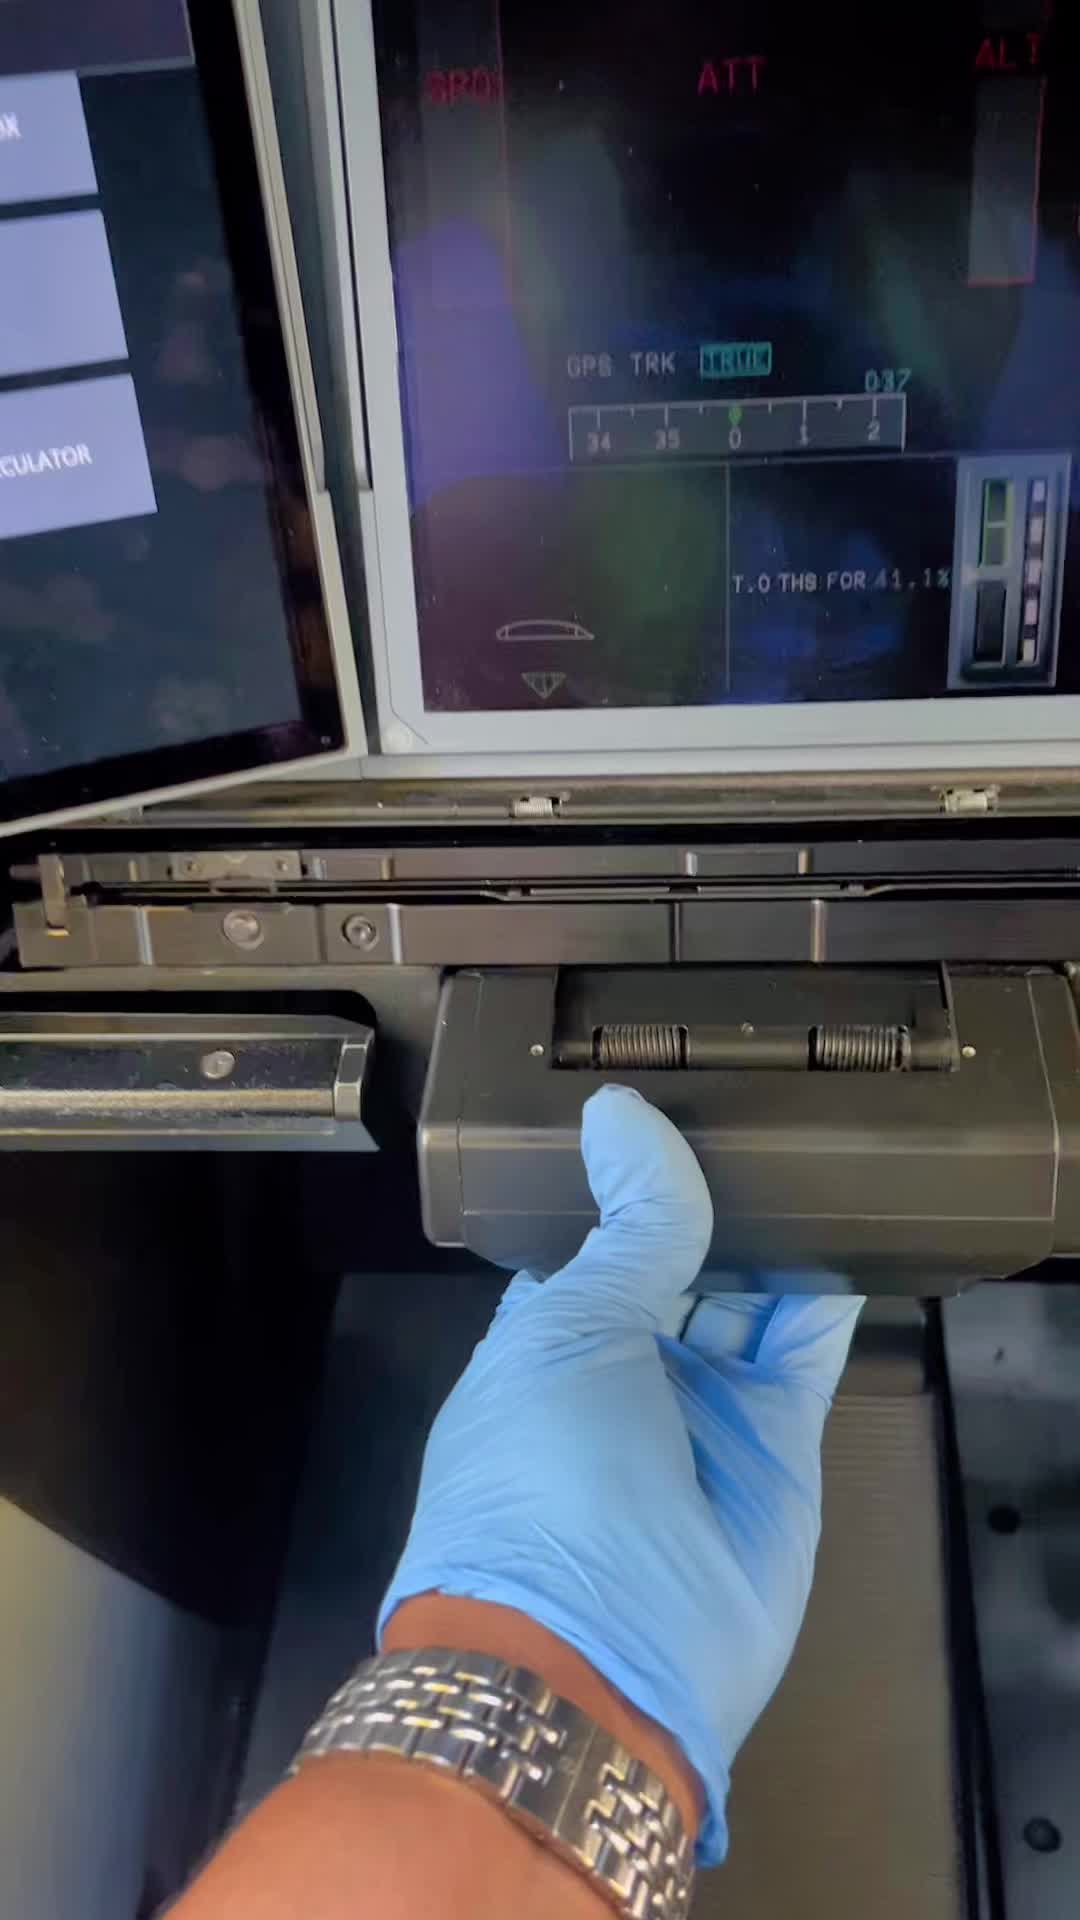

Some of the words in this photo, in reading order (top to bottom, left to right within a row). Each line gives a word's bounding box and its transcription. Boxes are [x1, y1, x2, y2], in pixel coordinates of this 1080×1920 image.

[974, 32, 1041, 70] ALT
[698, 56, 764, 95] ATT
[567, 353, 612, 378] GPS
[630, 351, 676, 377] TRK
[728, 428, 742, 450] 0
[799, 424, 809, 446] 1
[867, 421, 880, 442] 2
[0, 443, 93, 478] CULATOR
[778, 572, 817, 593] THS
[826, 570, 866, 592] FOR
